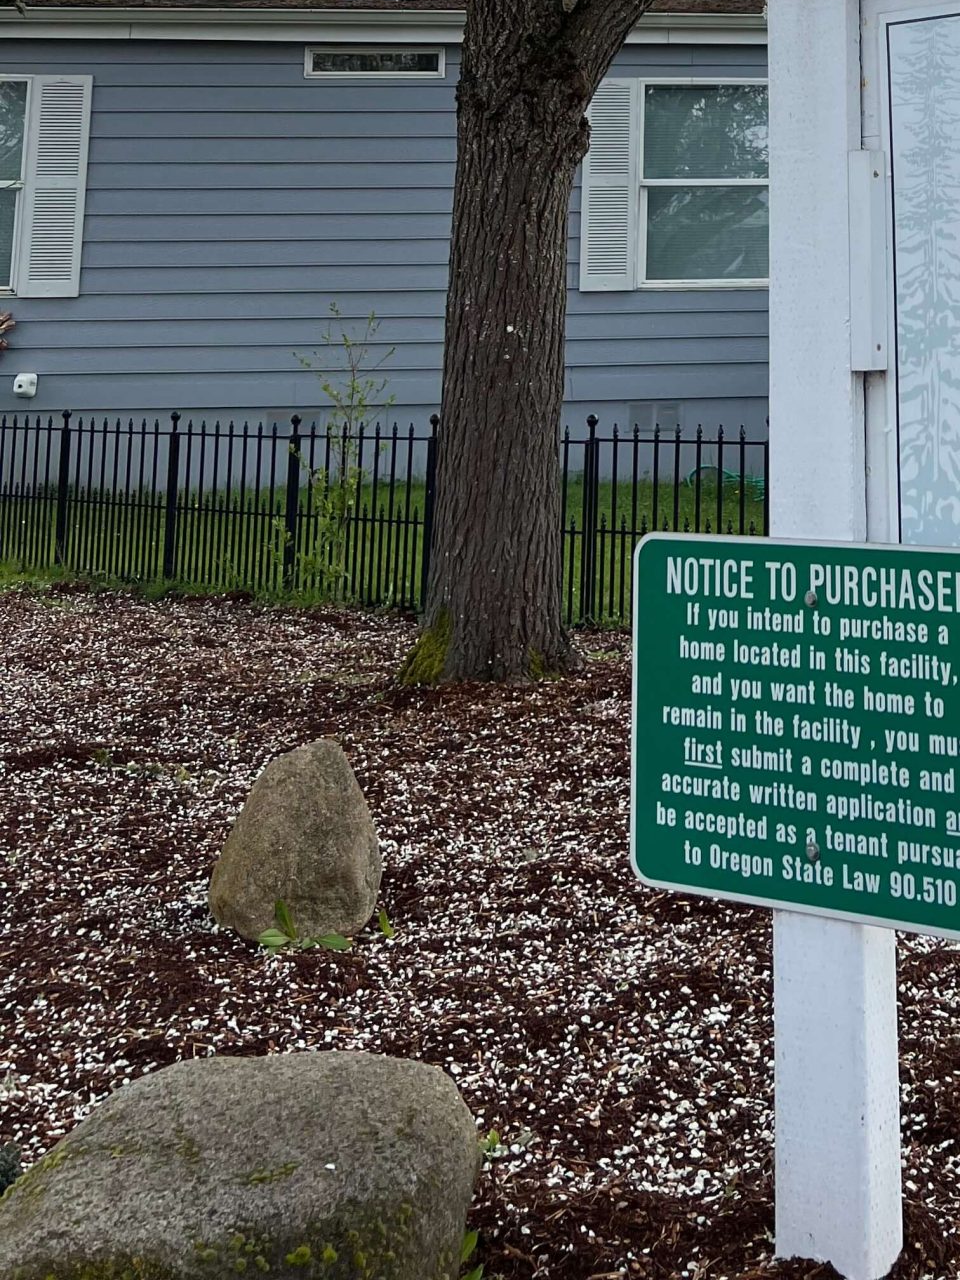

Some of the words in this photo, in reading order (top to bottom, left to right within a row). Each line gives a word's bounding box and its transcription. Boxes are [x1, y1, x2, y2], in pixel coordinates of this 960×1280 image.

[667, 557, 753, 598] NOTICE
[765, 562, 796, 601] TO
[687, 602, 699, 625] If
[708, 609, 738, 630] you
[747, 606, 803, 633] intend
[813, 611, 830, 635] to
[840, 616, 928, 643] purchase
[938, 625, 948, 644] a
[680, 635, 725, 661] home
[734, 639, 800, 668] located
[810, 646, 825, 670] in
[835, 648, 870, 674] this
[880, 652, 957, 685] facility,
[692, 672, 722, 695] and
[731, 679, 761, 700] you
[771, 681, 815, 704] want
[825, 682, 854, 708] the
[864, 686, 914, 715] home
[924, 692, 944, 718] to
[663, 705, 722, 729] remain
[731, 708, 746, 732] in
[755, 710, 783, 736] the
[793, 714, 860, 749] facility
[885, 730, 919, 753] you
[684, 737, 722, 764] first
[731, 745, 792, 772] submit
[802, 756, 811, 775] a
[821, 759, 909, 787] complete
[920, 768, 954, 793] and
[662, 773, 740, 801] accurate
[749, 782, 817, 811] written
[827, 794, 935, 828] application
[657, 801, 676, 826] be
[685, 811, 767, 839] accepted
[776, 824, 796, 844] as
[806, 828, 816, 845] a
[825, 825, 888, 857] tenant
[684, 840, 701, 865] to
[710, 844, 772, 877] Oregon
[782, 855, 833, 886] State
[843, 864, 880, 893] Law
[890, 872, 956, 906] 90.510
